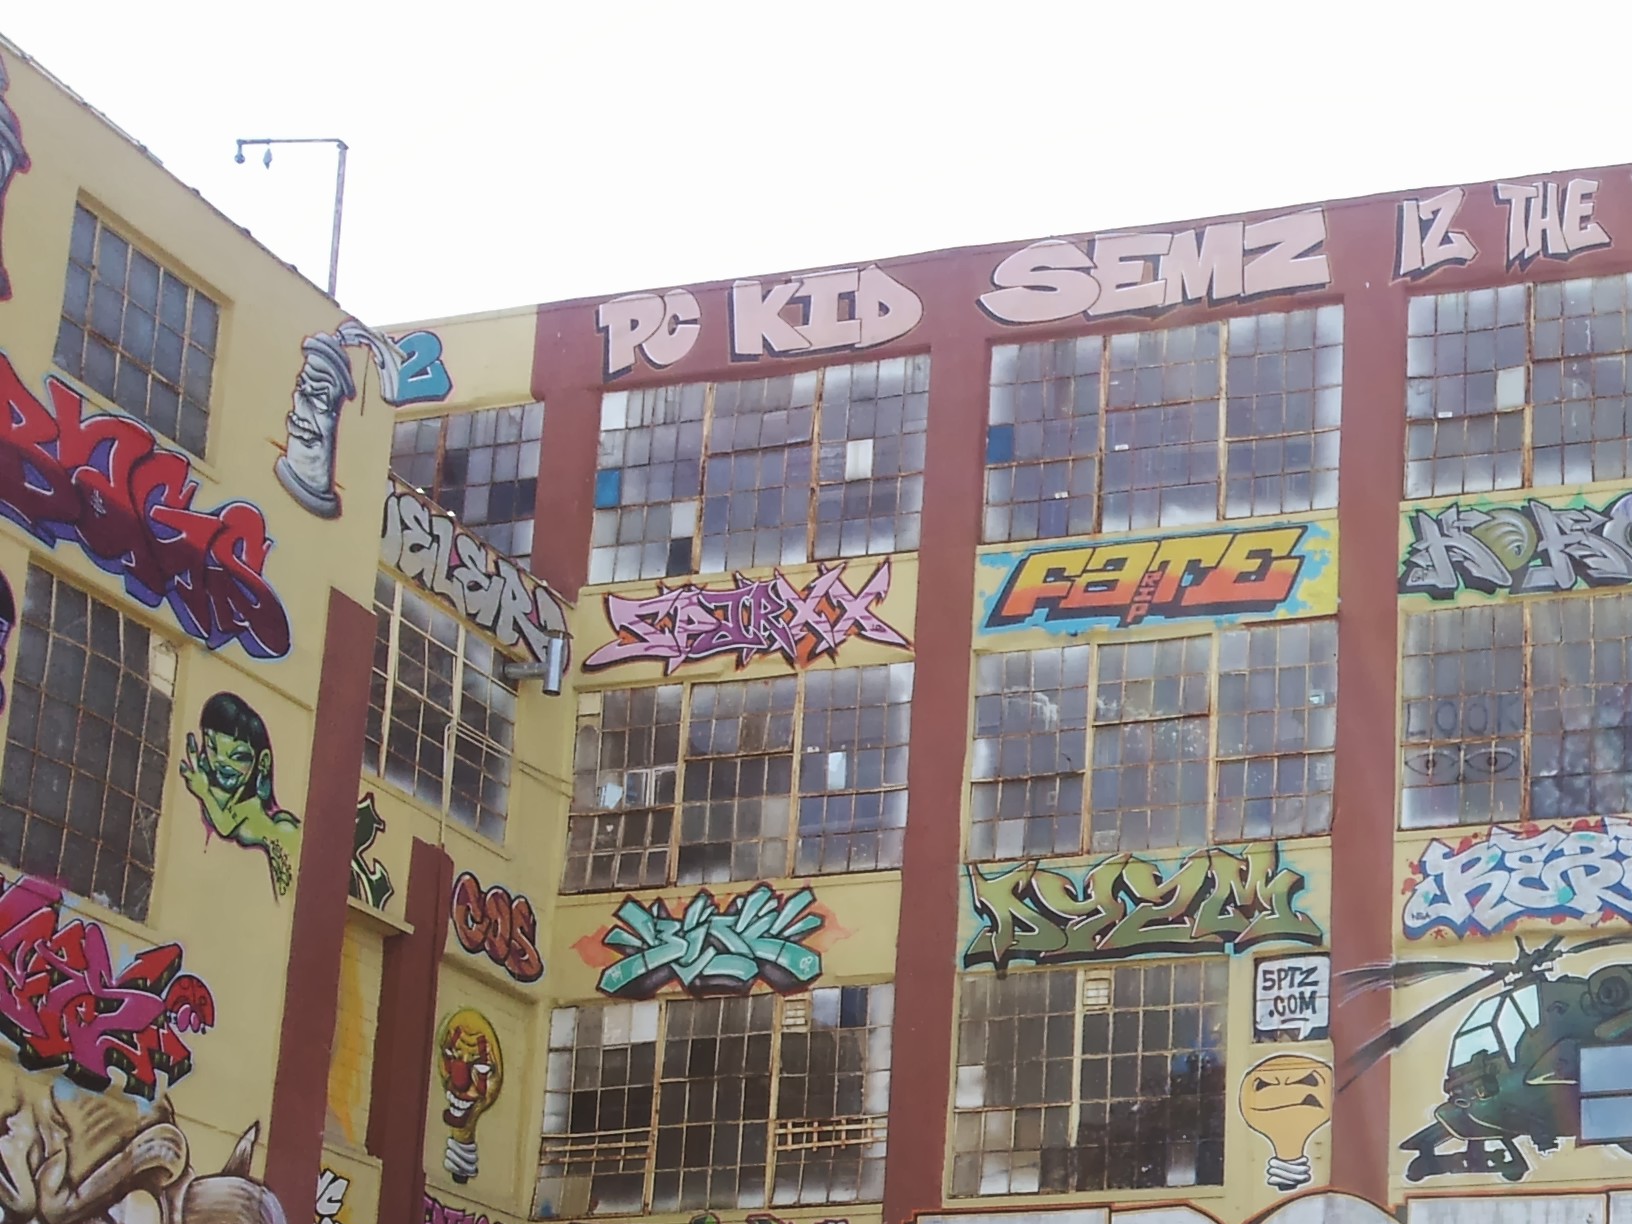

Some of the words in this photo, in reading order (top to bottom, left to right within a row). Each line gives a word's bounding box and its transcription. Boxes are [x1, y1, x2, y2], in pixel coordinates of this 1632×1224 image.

[977, 208, 1331, 323] SEMZ
[1396, 187, 1477, 280] IZ
[1496, 178, 1610, 267] THE
[597, 288, 703, 374] PC
[728, 263, 924, 361] KID
[1261, 964, 1320, 990] 5PTZ
[1268, 993, 1318, 1018] .COM
